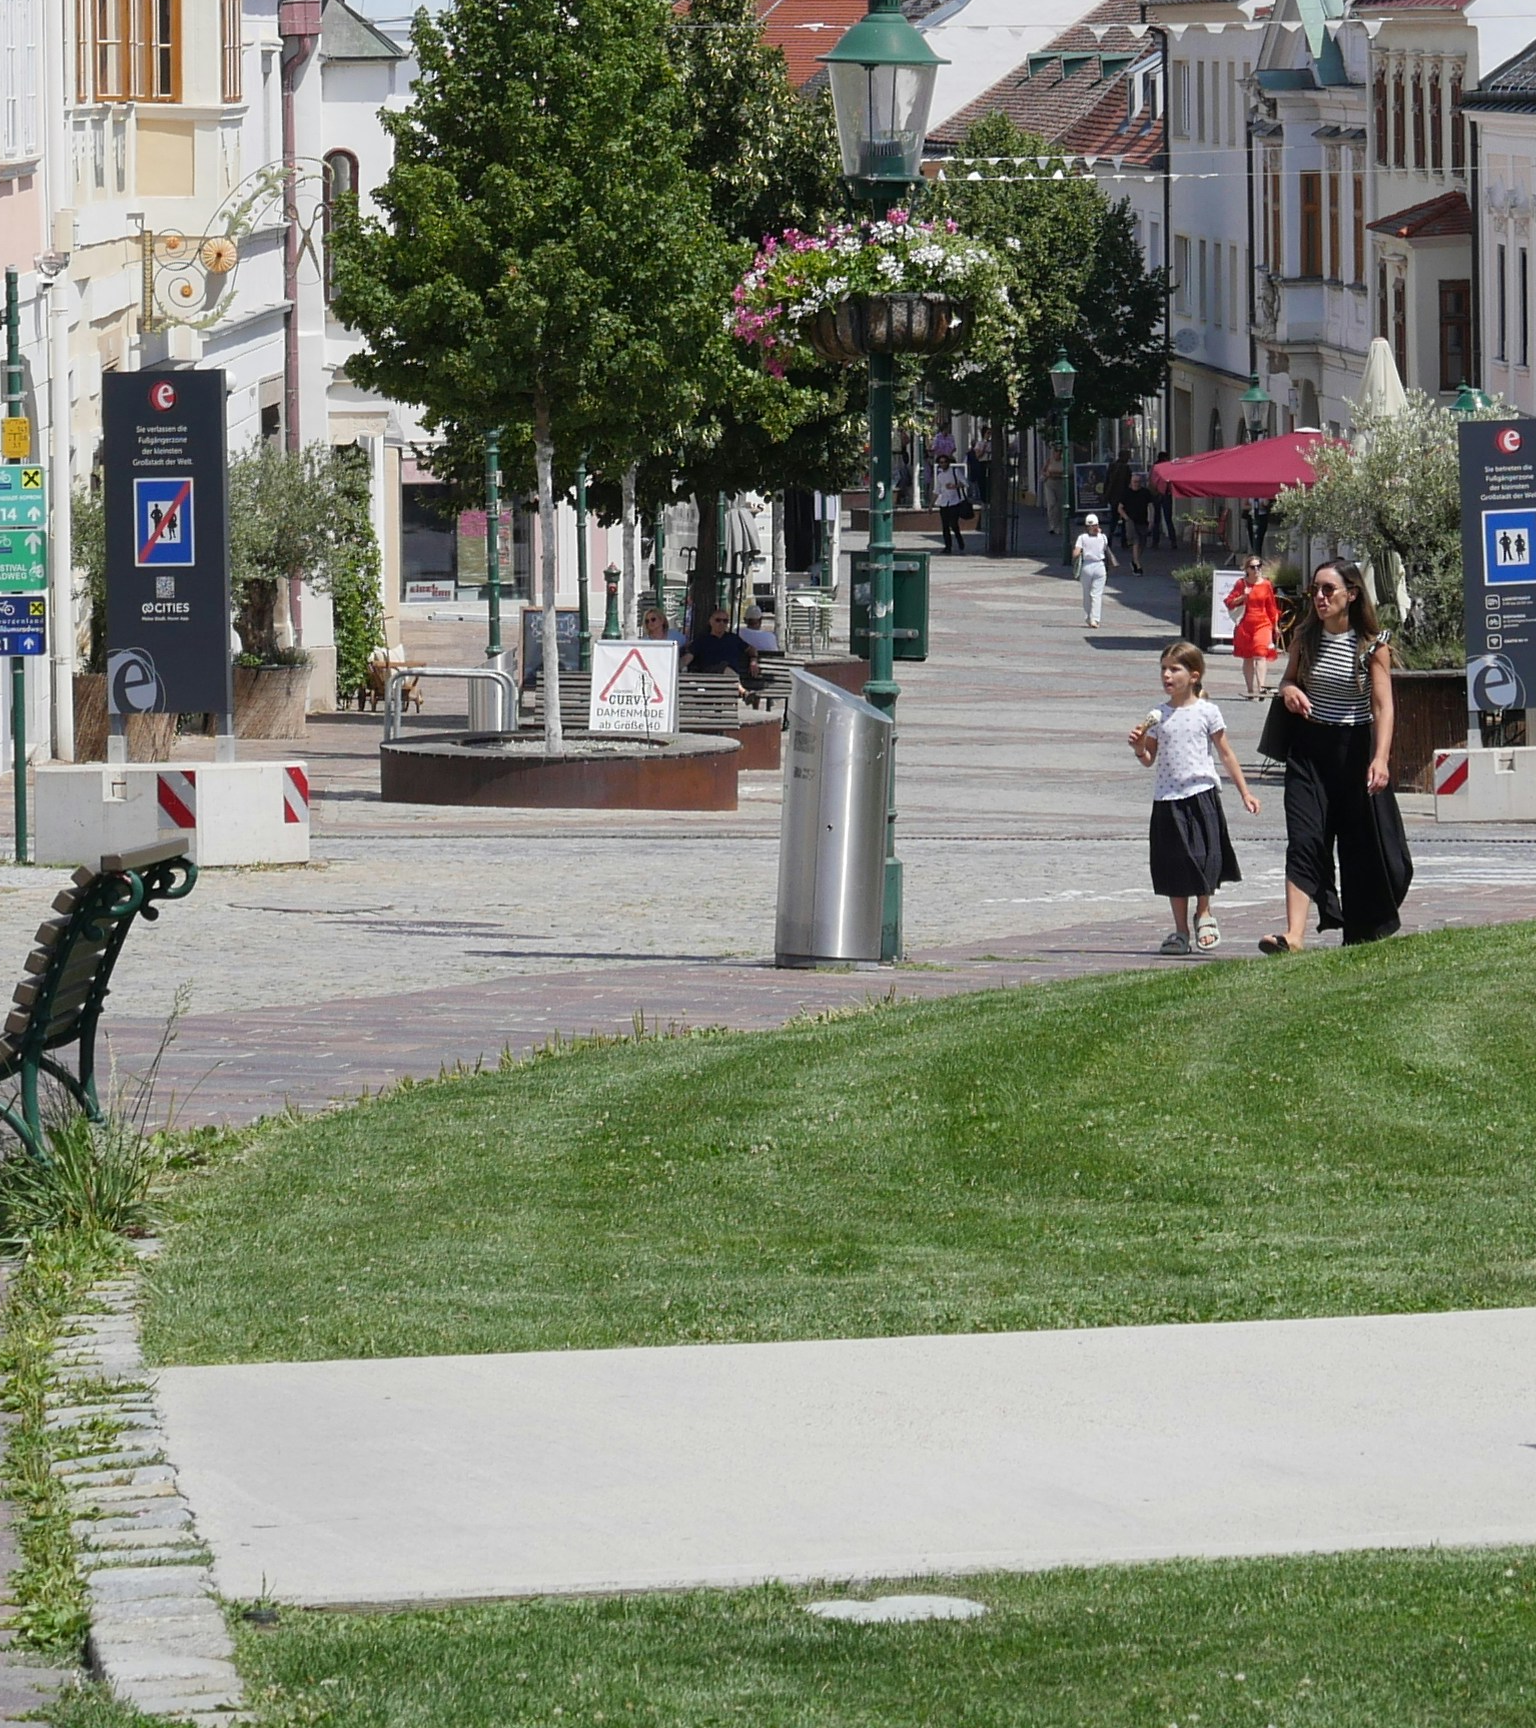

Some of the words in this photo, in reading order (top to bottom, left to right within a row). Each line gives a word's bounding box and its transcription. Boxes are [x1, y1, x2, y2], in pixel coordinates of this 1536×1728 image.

[138, 436, 187, 445] Fußgängerzone
[132, 458, 164, 466] Großstadt
[165, 458, 176, 466] der
[1486, 474, 1534, 482] Fußgängerzone
[155, 603, 190, 613] CITIES
[609, 695, 651, 705] CURVY
[596, 708, 664, 718] DAMENMODE
[599, 721, 611, 730] ab
[614, 721, 644, 730] Größe
